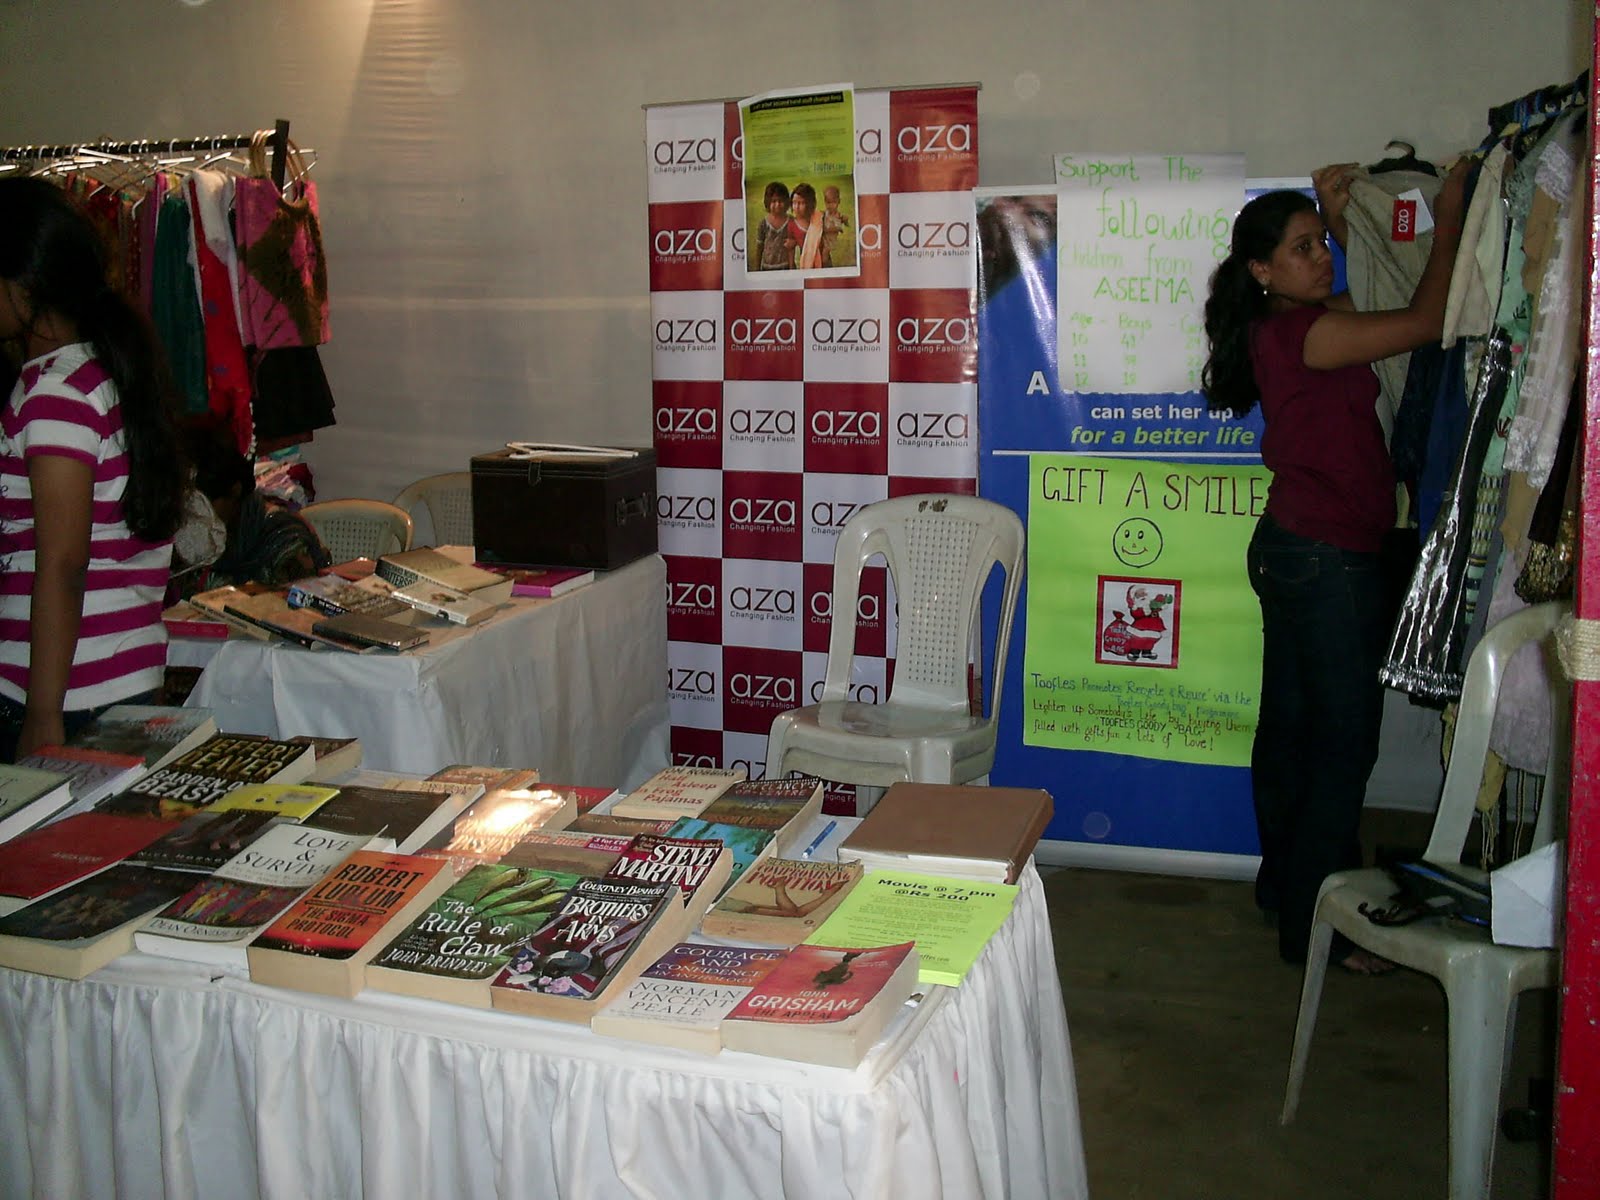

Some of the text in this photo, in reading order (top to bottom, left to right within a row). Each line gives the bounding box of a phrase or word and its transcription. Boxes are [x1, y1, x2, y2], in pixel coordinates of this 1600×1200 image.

[897, 124, 970, 153] aza
[654, 138, 716, 165] aza
[897, 152, 970, 162] Changing Fashion
[689, 164, 716, 172] Fashion
[1059, 156, 1203, 186] Support The
[1096, 187, 1229, 261] following
[655, 229, 716, 255] aza
[898, 222, 969, 249] aza
[1094, 277, 1194, 303] ASEEMA
[656, 319, 716, 344] aza
[730, 318, 796, 345] aza
[811, 318, 881, 344] aza
[897, 318, 969, 345] aza
[656, 344, 686, 352] Changing
[731, 344, 765, 352] Changing
[812, 344, 881, 353] Changing Fashion
[897, 344, 969, 353] Changing Fashion
[1026, 370, 1050, 395] A
[656, 407, 717, 433] aza
[730, 409, 796, 435] aza
[1091, 404, 1234, 422] can set her up
[811, 410, 881, 438] aza
[897, 412, 968, 439] aza
[657, 432, 686, 441] Changing
[730, 434, 795, 443] Changing Fashion
[811, 435, 880, 445] Changing Fashion
[897, 438, 968, 448] Changing Fashion
[1071, 425, 1255, 445] for a better life
[1042, 466, 1263, 517] GIFT A SMILE
[657, 495, 715, 521] aza
[730, 498, 796, 525] aza
[811, 502, 858, 526] az
[687, 520, 715, 528] Fashion
[730, 523, 795, 533] Changing Fashion
[730, 586, 795, 614] aza
[688, 608, 715, 616] Fashion
[730, 611, 795, 622] Changing Fashion
[731, 673, 795, 702] aza
[688, 693, 715, 702] Fashion
[731, 697, 795, 709] Changing Fashion
[1235, 691, 1251, 704] the
[205, 738, 302, 761] JEFFERY
[177, 751, 283, 778] DEAVER
[152, 769, 226, 790] GARDEN
[672, 780, 717, 790] Asleep
[132, 778, 228, 803] BEAST
[643, 794, 704, 805] Pajamas
[652, 787, 683, 797] Frog
[294, 832, 354, 851] LOVE
[236, 851, 332, 874] SURVIVA
[296, 849, 316, 862] &
[647, 844, 720, 867] STEVE
[333, 863, 423, 889] ROBERT
[608, 857, 707, 886] MARTINI
[579, 880, 665, 896] COURTNEY BISHOP
[878, 879, 928, 890] Movie
[968, 890, 996, 898] pm
[895, 889, 969, 901] @Rs 200
[302, 906, 370, 926] THE SIGMA
[443, 901, 475, 914] The
[560, 896, 653, 921] BROTHERS
[286, 919, 355, 939] PROTOCOL
[418, 912, 513, 936] Rule of
[588, 915, 606, 925] IN
[552, 920, 619, 943] ARMS
[440, 935, 503, 958] Claw
[674, 947, 780, 961] COURAGE
[381, 948, 493, 973] JOHN BRINDLEY
[692, 959, 742, 968] AND
[656, 963, 764, 978] CONFIDENCE
[671, 972, 754, 983] ANTHOLOGY
[633, 981, 743, 998] NORMAN
[799, 990, 830, 998] JOHN
[627, 991, 734, 1008] VINCENT
[631, 1001, 704, 1017] PEALE
[748, 995, 859, 1011] GRISHAM
[753, 1008, 780, 1017] THE
[782, 1010, 833, 1019] APPEAL
